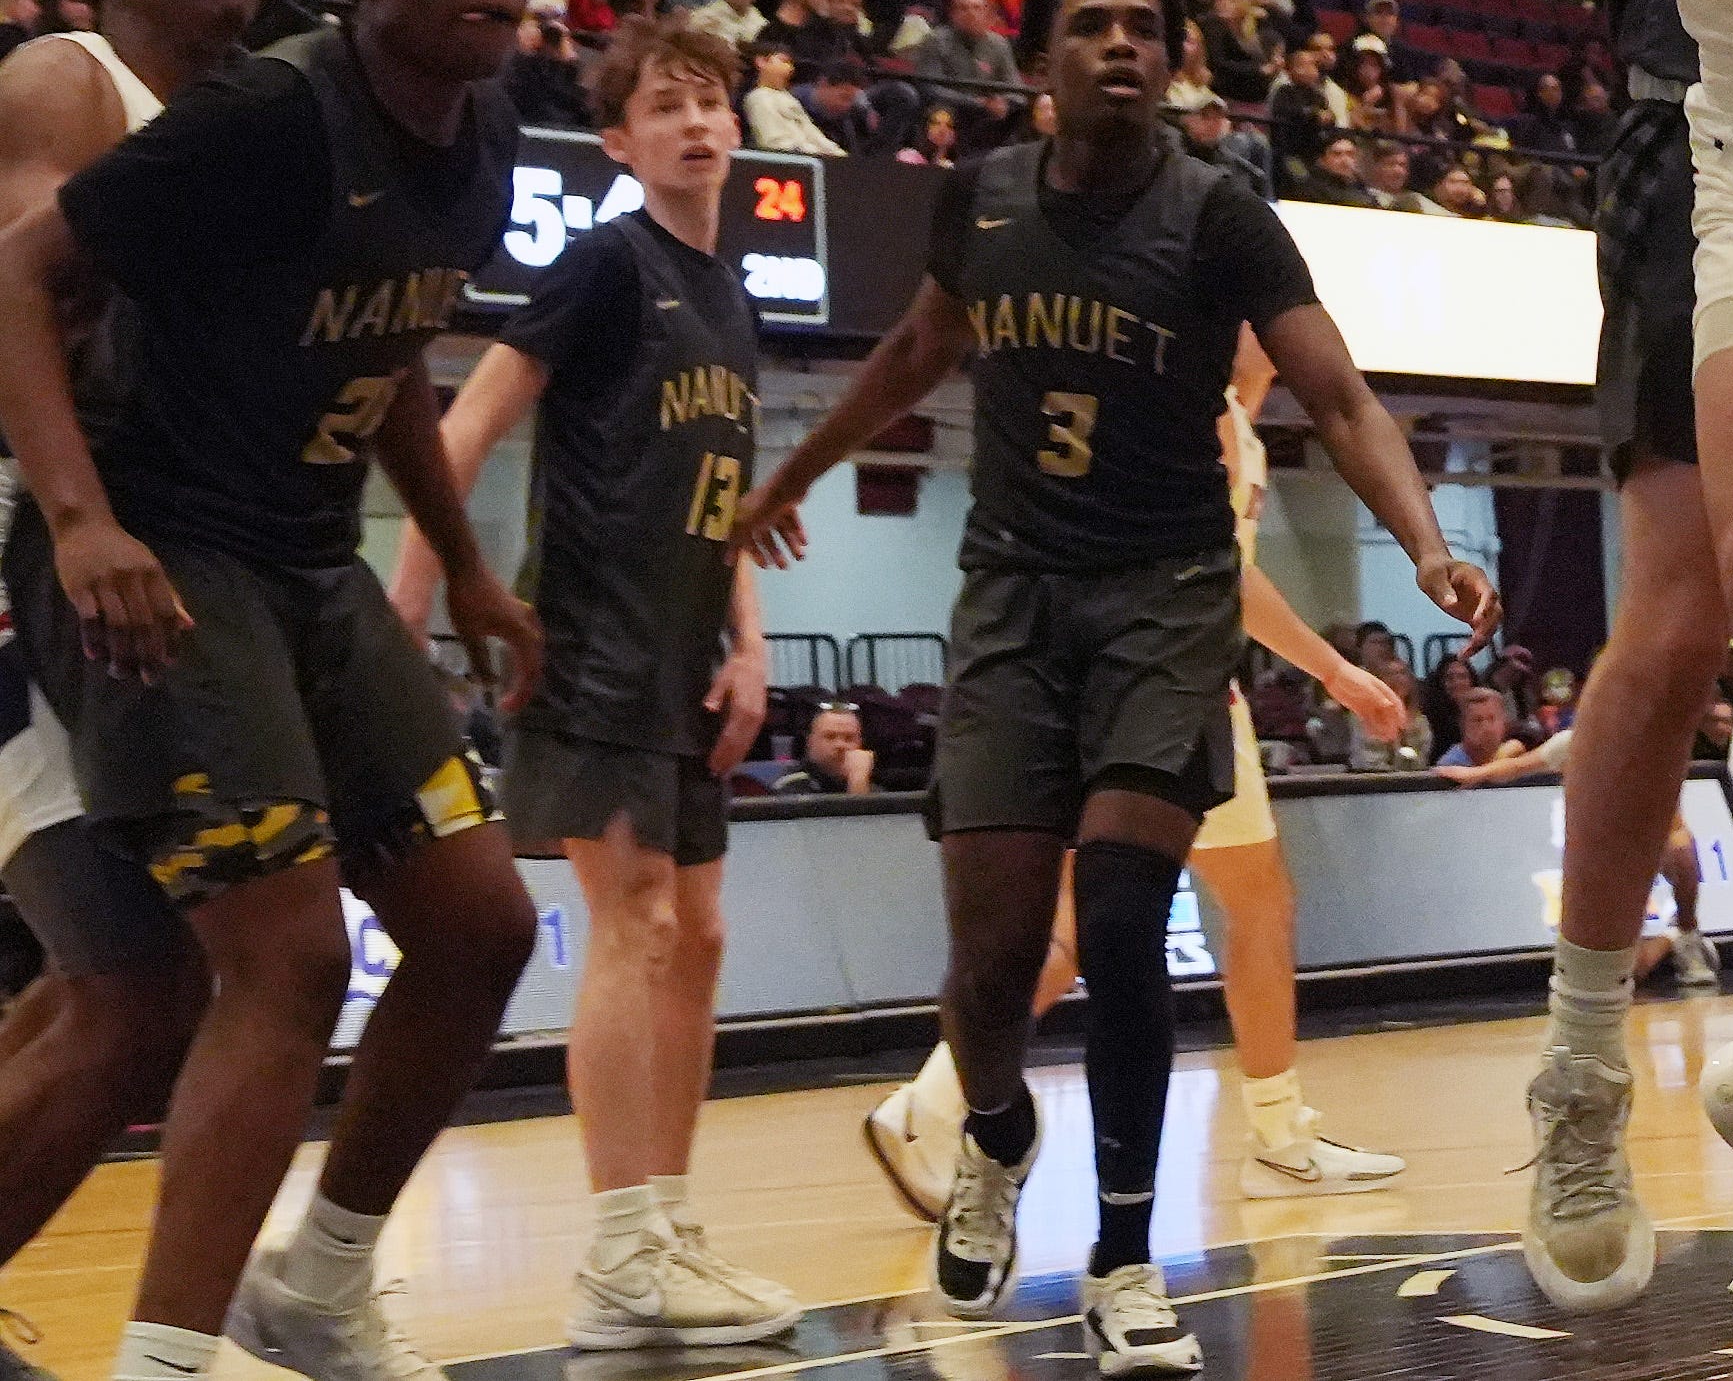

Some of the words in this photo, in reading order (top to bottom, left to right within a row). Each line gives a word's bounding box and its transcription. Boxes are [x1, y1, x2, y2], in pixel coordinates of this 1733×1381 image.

[753, 176, 808, 224] 24
[1036, 390, 1099, 478] 3
[685, 450, 742, 542] 13
